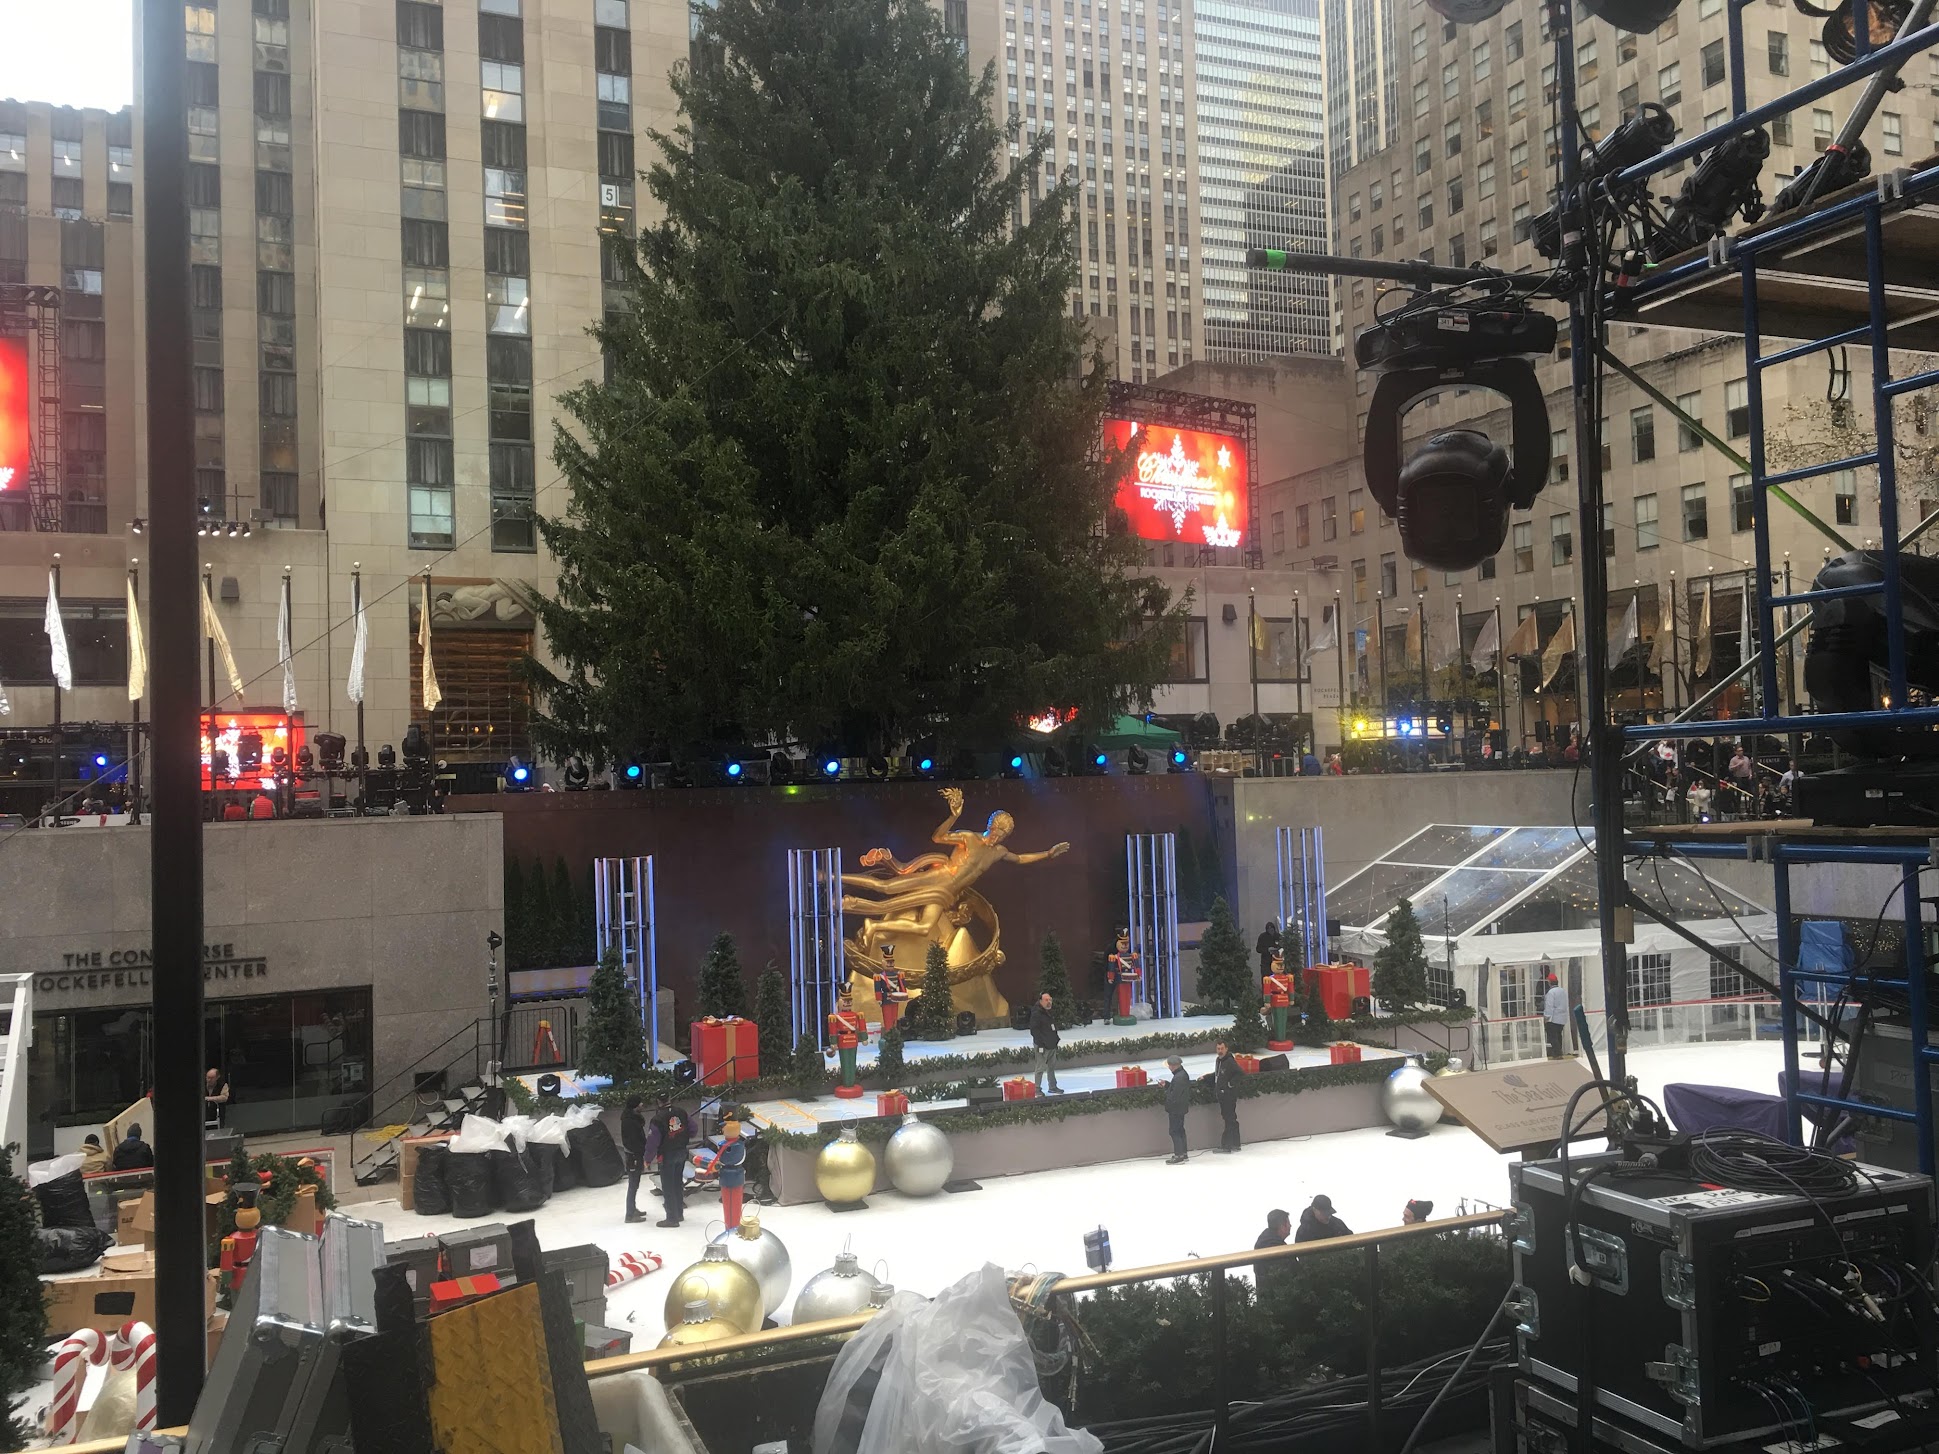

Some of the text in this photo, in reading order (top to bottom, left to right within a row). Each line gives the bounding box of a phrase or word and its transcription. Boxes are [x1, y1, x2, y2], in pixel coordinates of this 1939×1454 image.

[605, 188, 614, 202] 5
[63, 943, 234, 968] THE CONRSE
[204, 963, 267, 980] ENTER
